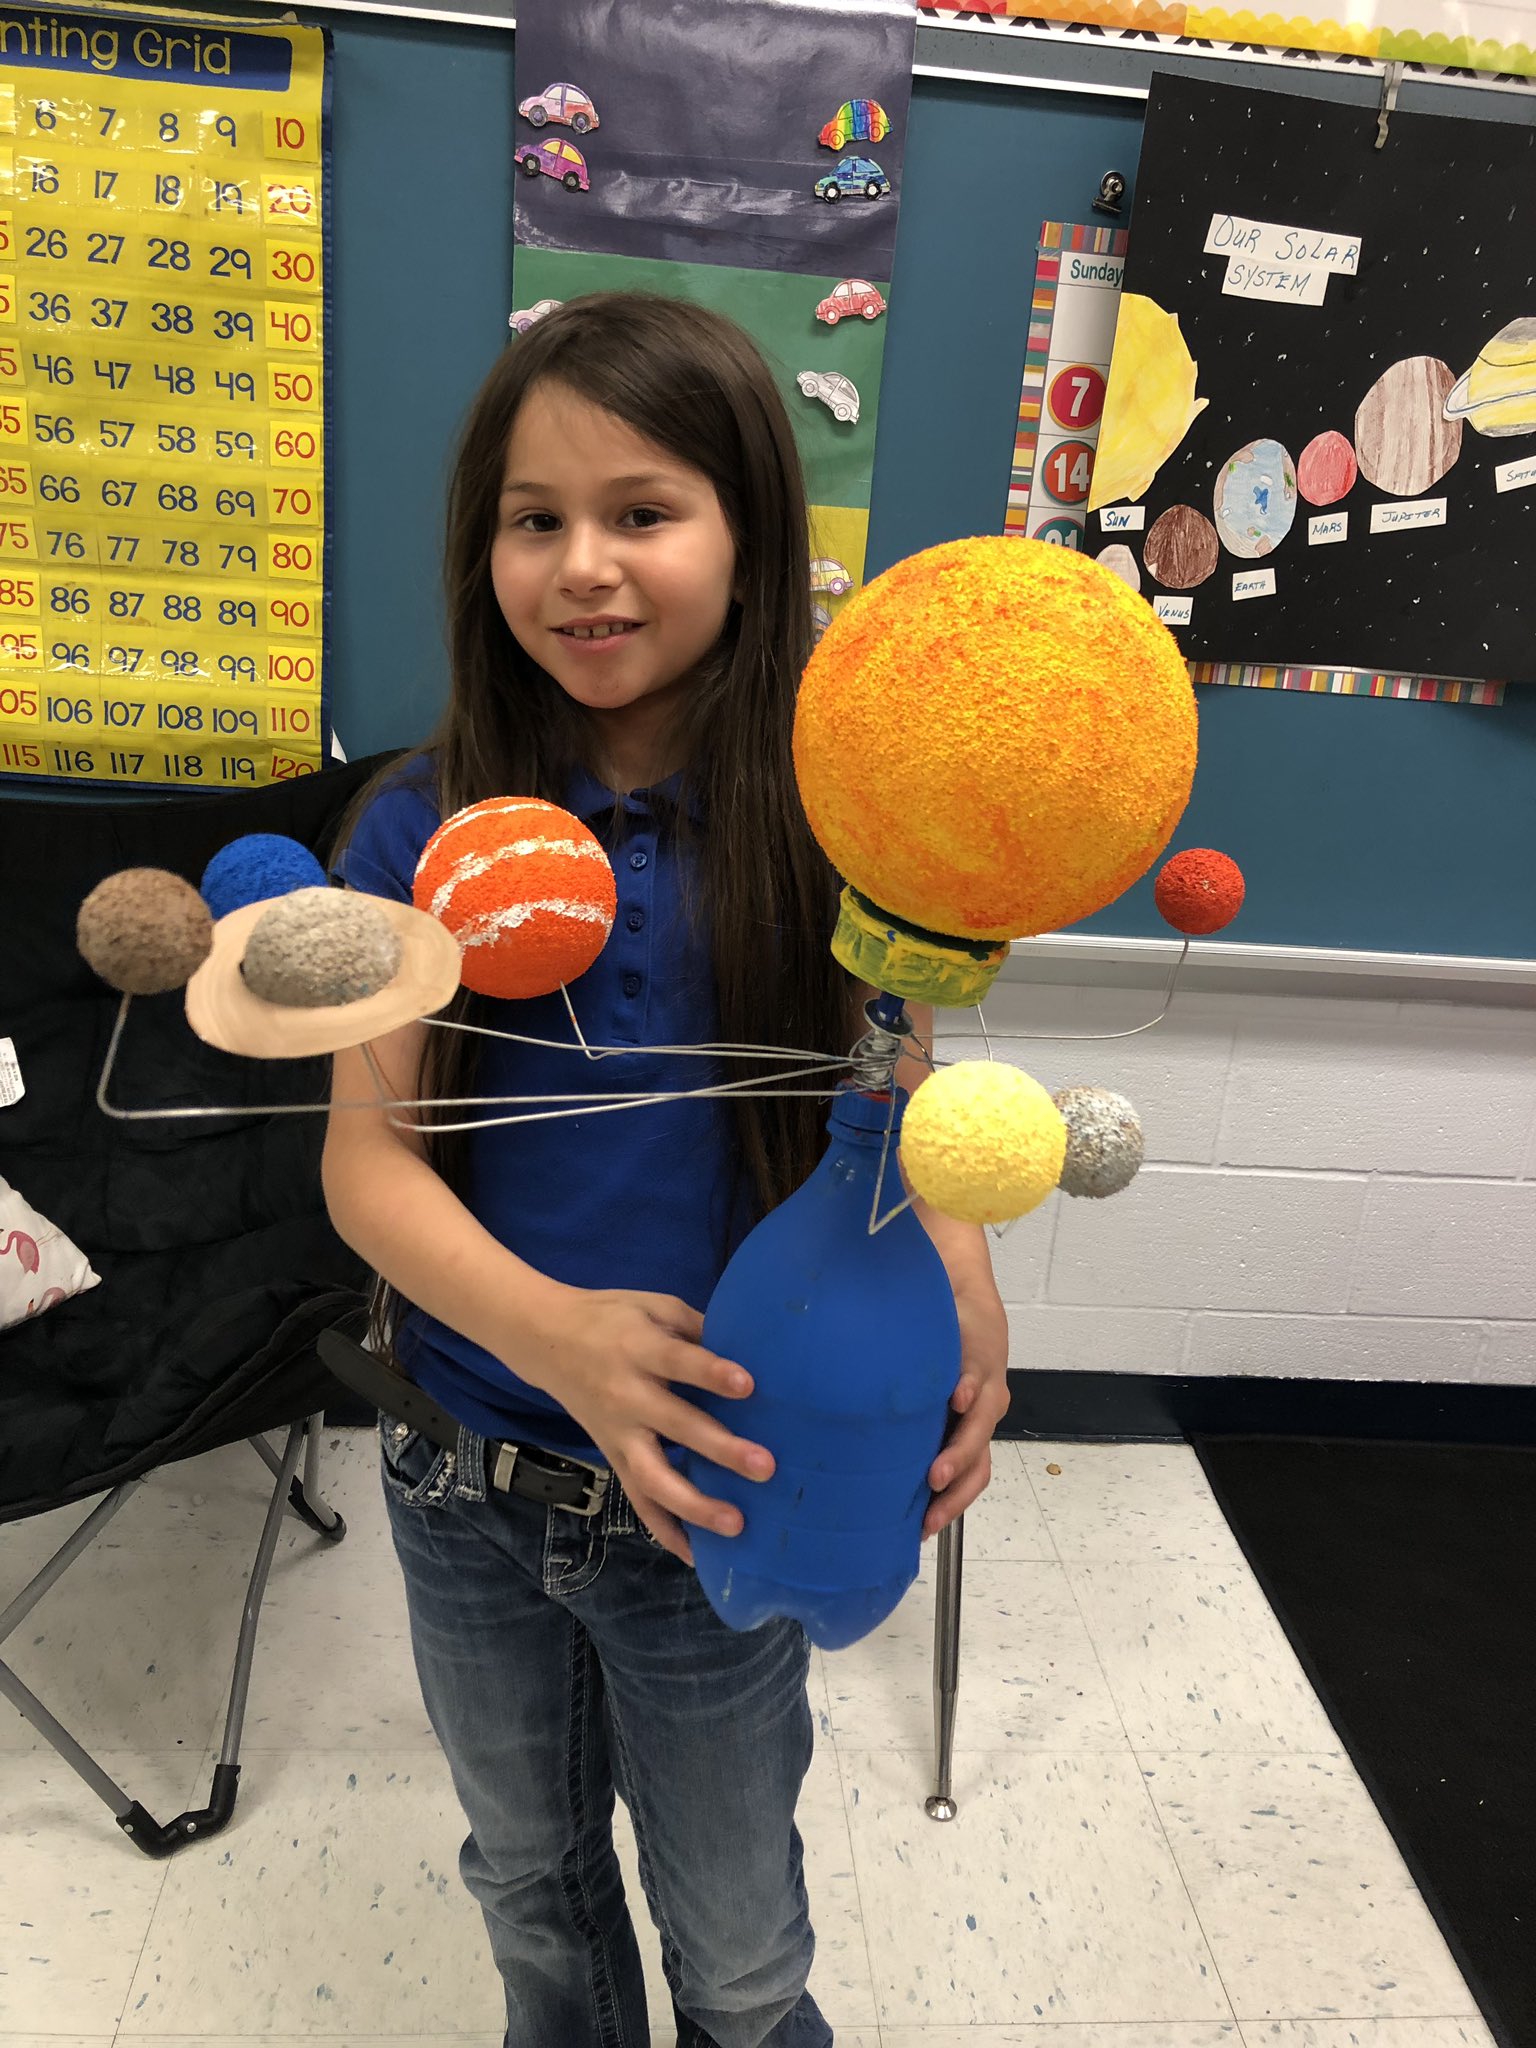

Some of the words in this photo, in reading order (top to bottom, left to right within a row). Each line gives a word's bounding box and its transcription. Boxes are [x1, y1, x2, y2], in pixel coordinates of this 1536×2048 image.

[133, 28, 231, 75] Grid
[34, 101, 57, 129] 6
[98, 107, 116, 136] 7
[160, 114, 179, 141] 8
[216, 116, 236, 146] 9
[275, 117, 305, 150] 10
[31, 163, 59, 194] 16
[95, 170, 119, 199] 17
[156, 176, 180, 205] 18
[214, 181, 242, 214] 19
[27, 228, 67, 258] 26
[88, 234, 124, 263] 27
[149, 239, 191, 271] 28
[211, 247, 251, 278] 29
[271, 250, 315, 283] 30
[1213, 215, 1261, 253] OUR
[1275, 231, 1359, 270] SOLAR
[1070, 258, 1124, 288] Sunday
[1228, 264, 1311, 297] SYSTEM
[29, 292, 71, 323] 36
[92, 299, 128, 328] 37
[153, 304, 194, 334] 38
[214, 310, 254, 342] 39
[270, 311, 311, 343] 40
[34, 355, 74, 384] 46
[95, 362, 131, 388] 47
[155, 366, 195, 395] 48
[215, 370, 255, 402] 49
[273, 372, 314, 402] 50
[1070, 376, 1091, 418] 7
[35, 415, 75, 442] 56
[101, 421, 134, 447] 57
[159, 425, 196, 453] 58
[217, 432, 254, 458] 59
[275, 430, 316, 459] 60
[1054, 452, 1090, 493] 14
[40, 474, 80, 503] 66
[102, 480, 137, 507] 67
[158, 484, 198, 512] 68
[216, 491, 255, 516] 69
[273, 488, 312, 515] 70
[1381, 507, 1441, 524] JUPITER
[1105, 510, 1131, 528] SUN
[1311, 521, 1343, 536] MARS
[47, 531, 85, 558] 76
[107, 536, 140, 562] 77
[162, 540, 200, 567] 78
[219, 545, 257, 572] 79
[272, 542, 312, 571] 80
[0, 579, 34, 607] 85
[51, 587, 90, 613] 86
[110, 591, 144, 617] 87
[163, 595, 201, 622] 88
[219, 601, 256, 627] 89
[270, 600, 310, 628] 90
[1233, 580, 1267, 593] EARTH
[1157, 602, 1190, 620] VENUS
[0, 633, 37, 660] 95
[51, 642, 90, 672] 96
[109, 648, 144, 672] 97
[161, 651, 199, 675] 98
[219, 655, 255, 681] 99
[269, 654, 315, 682] 100
[48, 698, 93, 723] 106
[104, 702, 145, 727] 107
[158, 704, 203, 730] 108
[213, 709, 257, 735] 109
[271, 707, 310, 733] 110
[2, 743, 41, 768] 115
[54, 749, 95, 772] 116
[110, 752, 144, 776] 117
[165, 755, 203, 777] 118
[222, 757, 256, 781] 119
